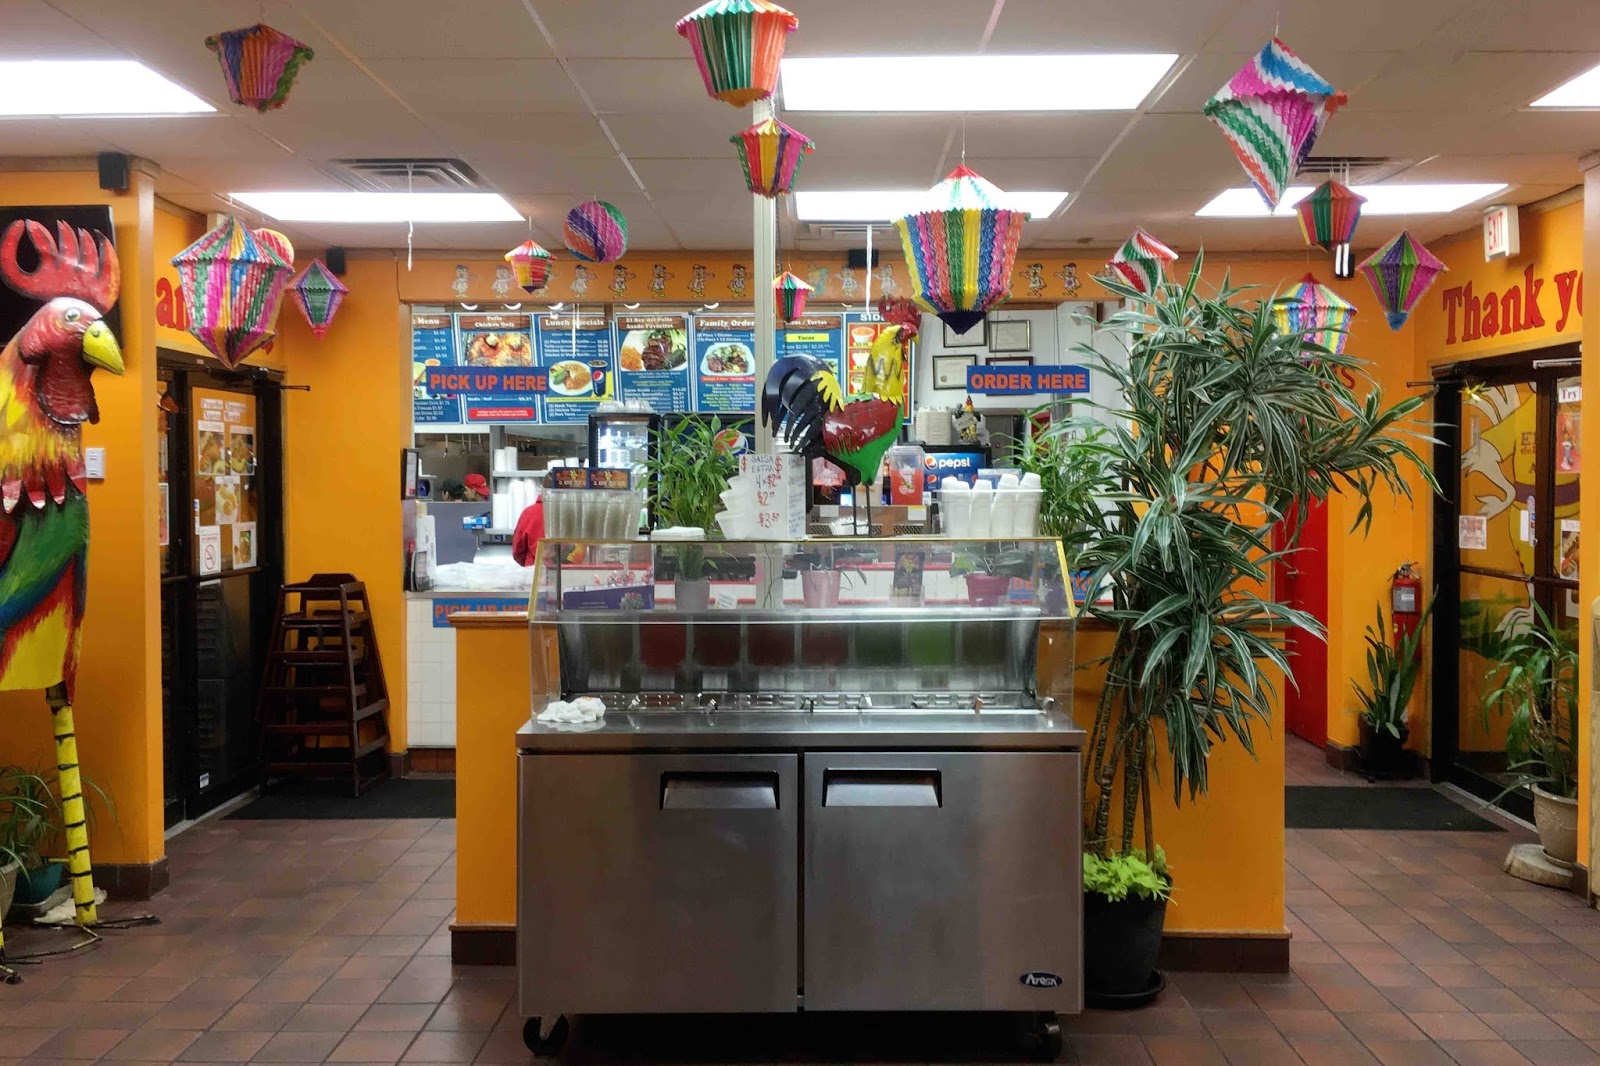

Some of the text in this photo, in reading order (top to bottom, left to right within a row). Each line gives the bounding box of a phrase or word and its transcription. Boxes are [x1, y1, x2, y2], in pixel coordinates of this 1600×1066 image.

[1487, 211, 1503, 250] EXIT
[1442, 263, 1545, 345] Thank
[417, 317, 440, 325] Menu
[699, 319, 729, 327] Family
[430, 374, 547, 391] PICK UP HERE
[970, 374, 1086, 390] ORDER HERE
[1561, 388, 1577, 400] Try
[750, 455, 774, 463] SALSA
[938, 457, 971, 469] pepsi
[751, 464, 774, 474] EXTRA
